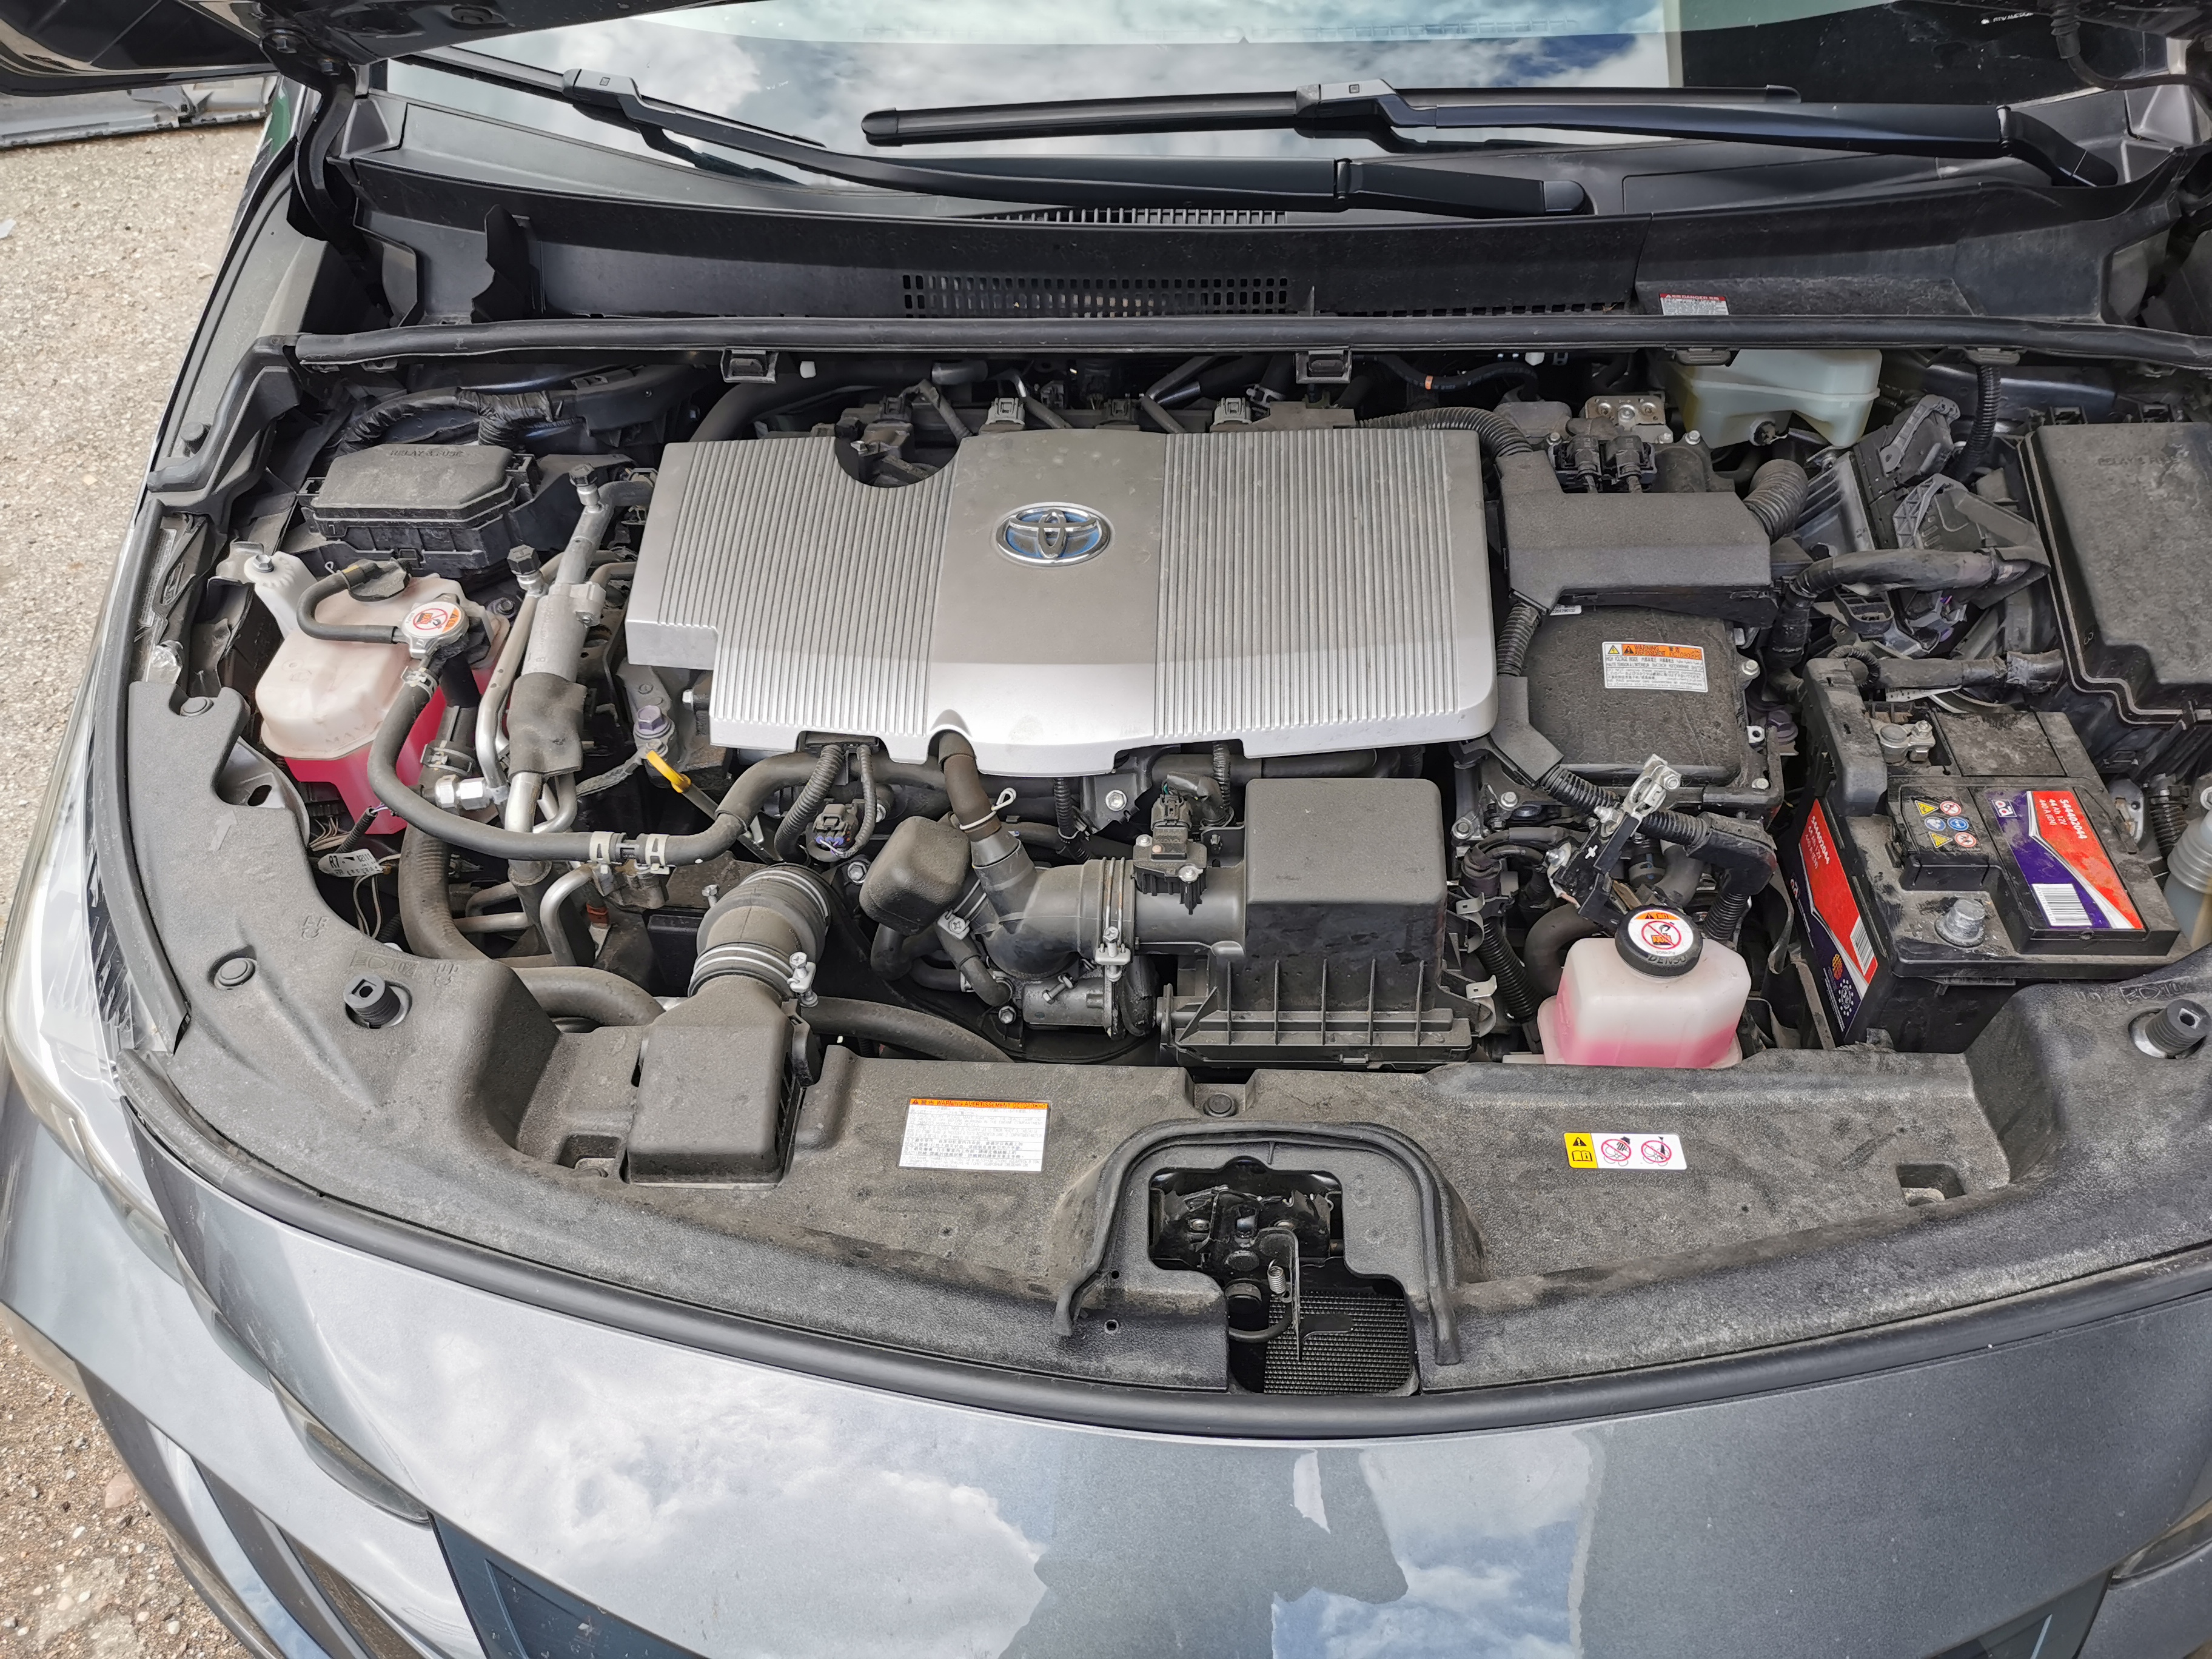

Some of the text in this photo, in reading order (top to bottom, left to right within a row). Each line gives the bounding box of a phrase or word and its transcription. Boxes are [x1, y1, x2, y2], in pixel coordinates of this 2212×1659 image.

[2039, 799, 2049, 810] 440
[2057, 816, 2068, 825] 12V
[2059, 799, 2088, 839] 544402044
[329, 855, 340, 869] R7
